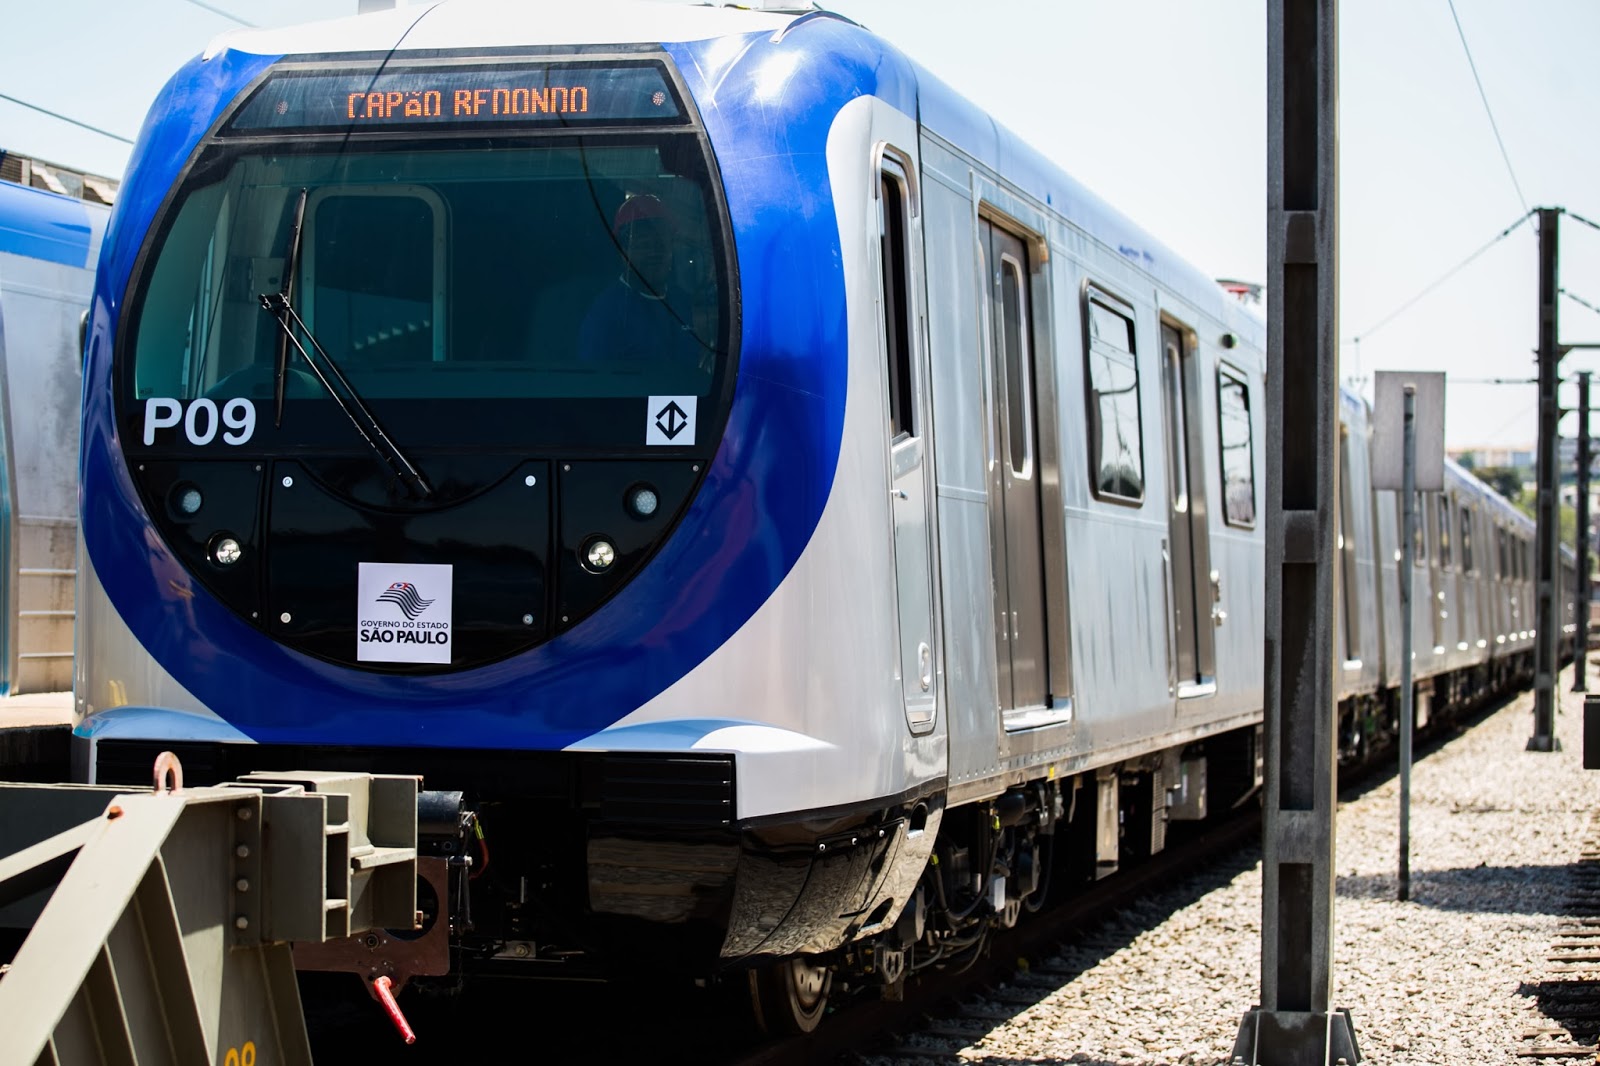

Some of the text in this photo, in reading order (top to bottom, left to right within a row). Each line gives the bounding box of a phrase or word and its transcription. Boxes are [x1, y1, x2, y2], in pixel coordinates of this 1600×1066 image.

[143, 397, 257, 446] P09
[360, 620, 401, 628] GOVERNO
[360, 627, 448, 644] SÃO PAULO
